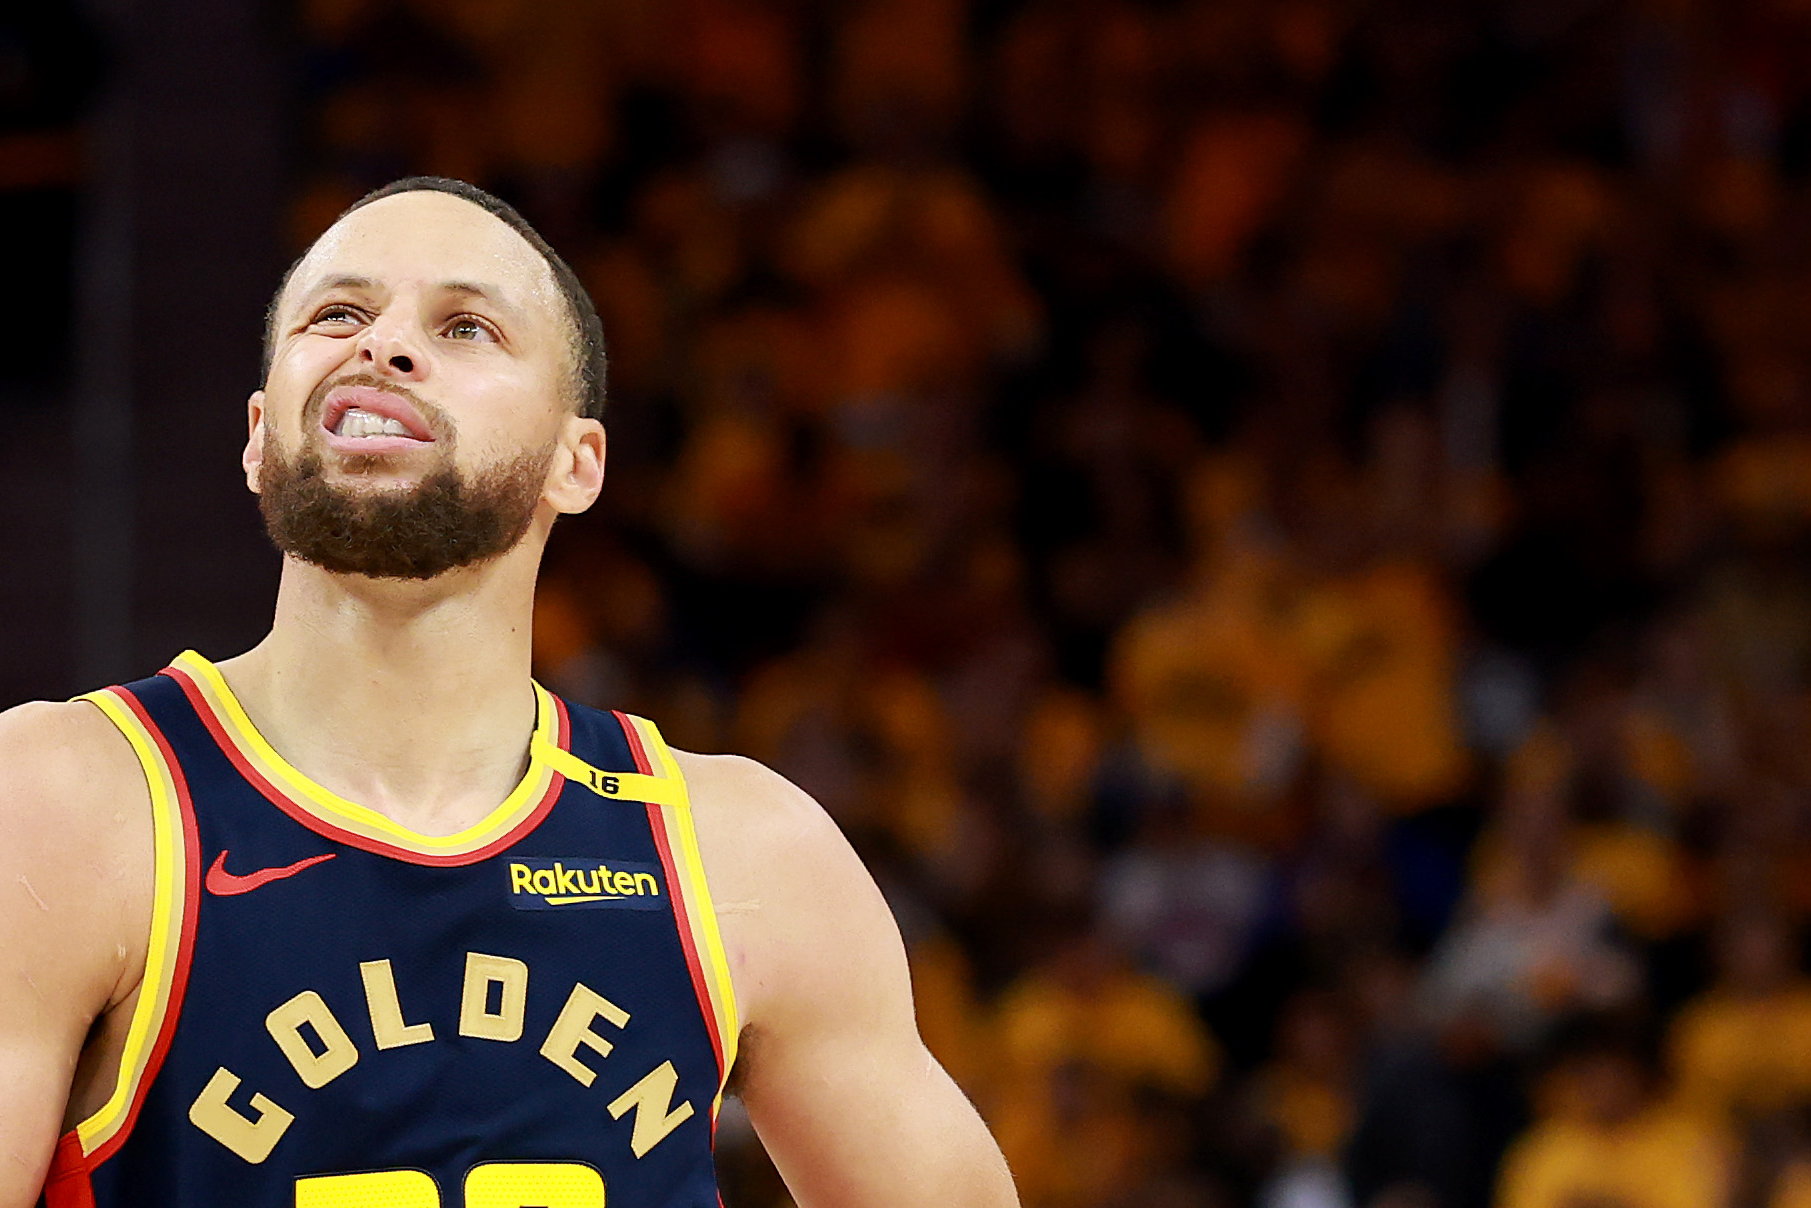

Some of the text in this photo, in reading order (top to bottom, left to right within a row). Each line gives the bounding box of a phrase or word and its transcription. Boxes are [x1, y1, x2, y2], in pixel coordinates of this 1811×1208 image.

[589, 770, 620, 795] 16
[509, 862, 660, 897] Rakuten
[189, 951, 694, 1164] GOLDEN
